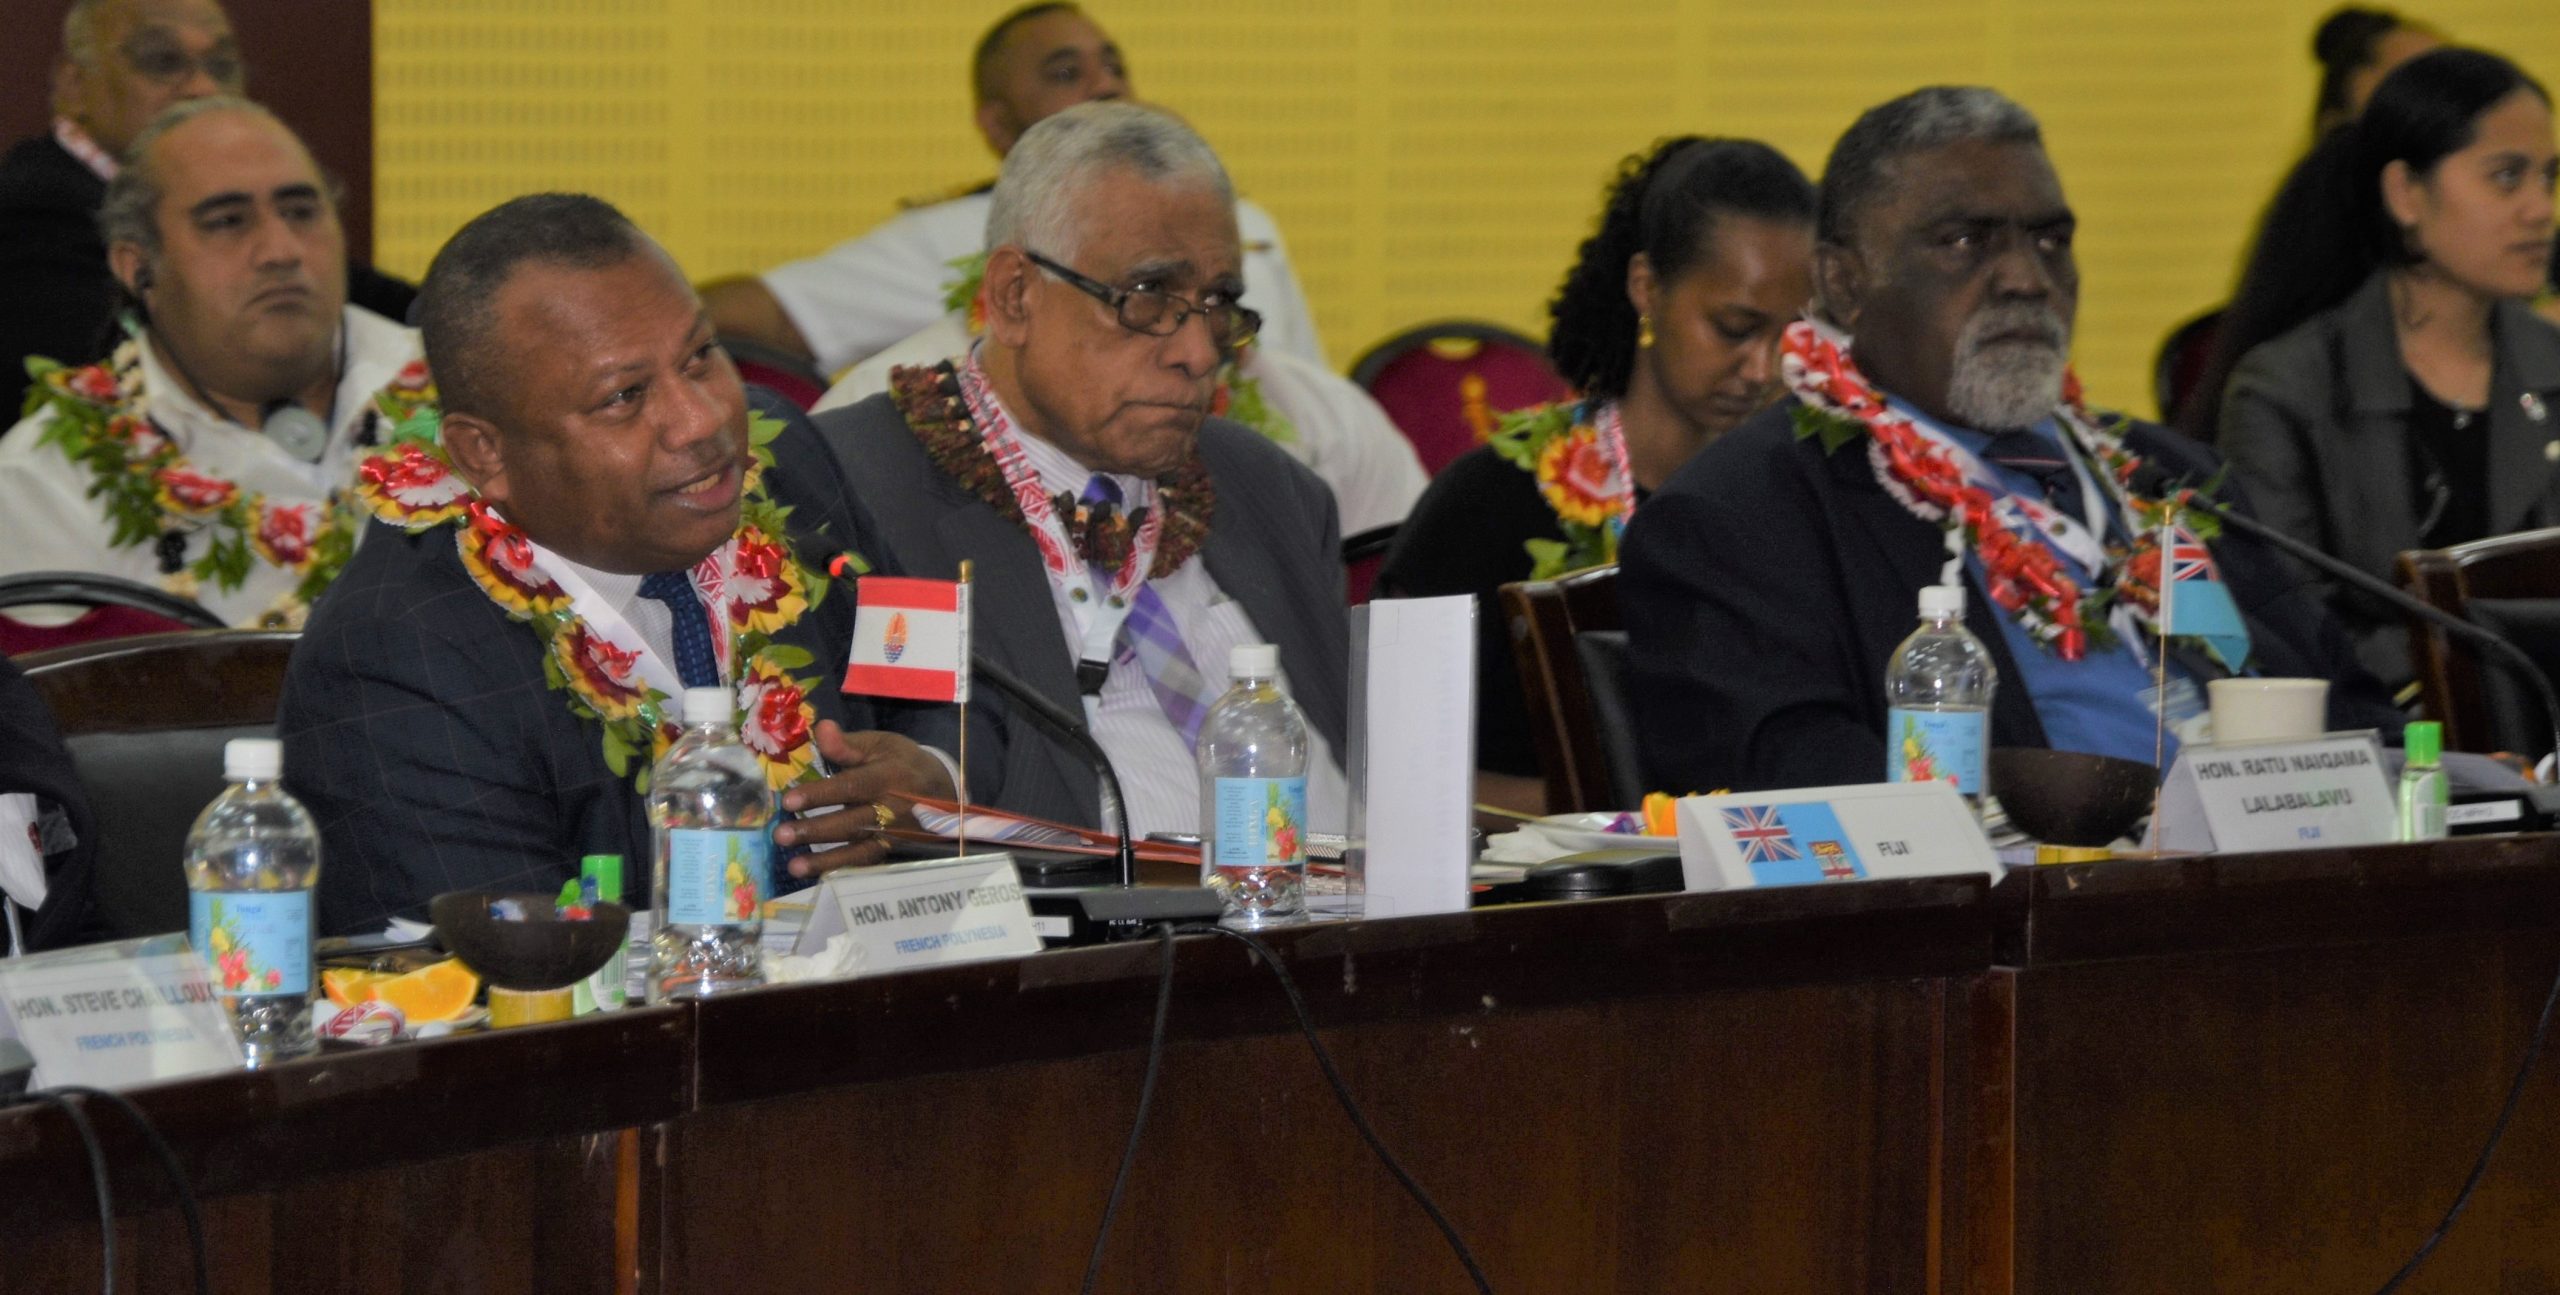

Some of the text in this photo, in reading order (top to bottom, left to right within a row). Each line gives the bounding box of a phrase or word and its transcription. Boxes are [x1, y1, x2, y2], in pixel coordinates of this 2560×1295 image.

[2196, 762, 2241, 780] HON.
[2243, 757, 2288, 777] RATU
[2242, 788, 2353, 814] LALABALAVU
[1876, 841, 1910, 856] FIJI
[850, 905, 894, 926] HON.
[897, 890, 963, 919] ANTONY
[894, 926, 1007, 953] FRENCH POLYNESIA
[15, 997, 62, 1020] HON.
[62, 989, 121, 1014] STEVE
[127, 1028, 195, 1046] POLESIA
